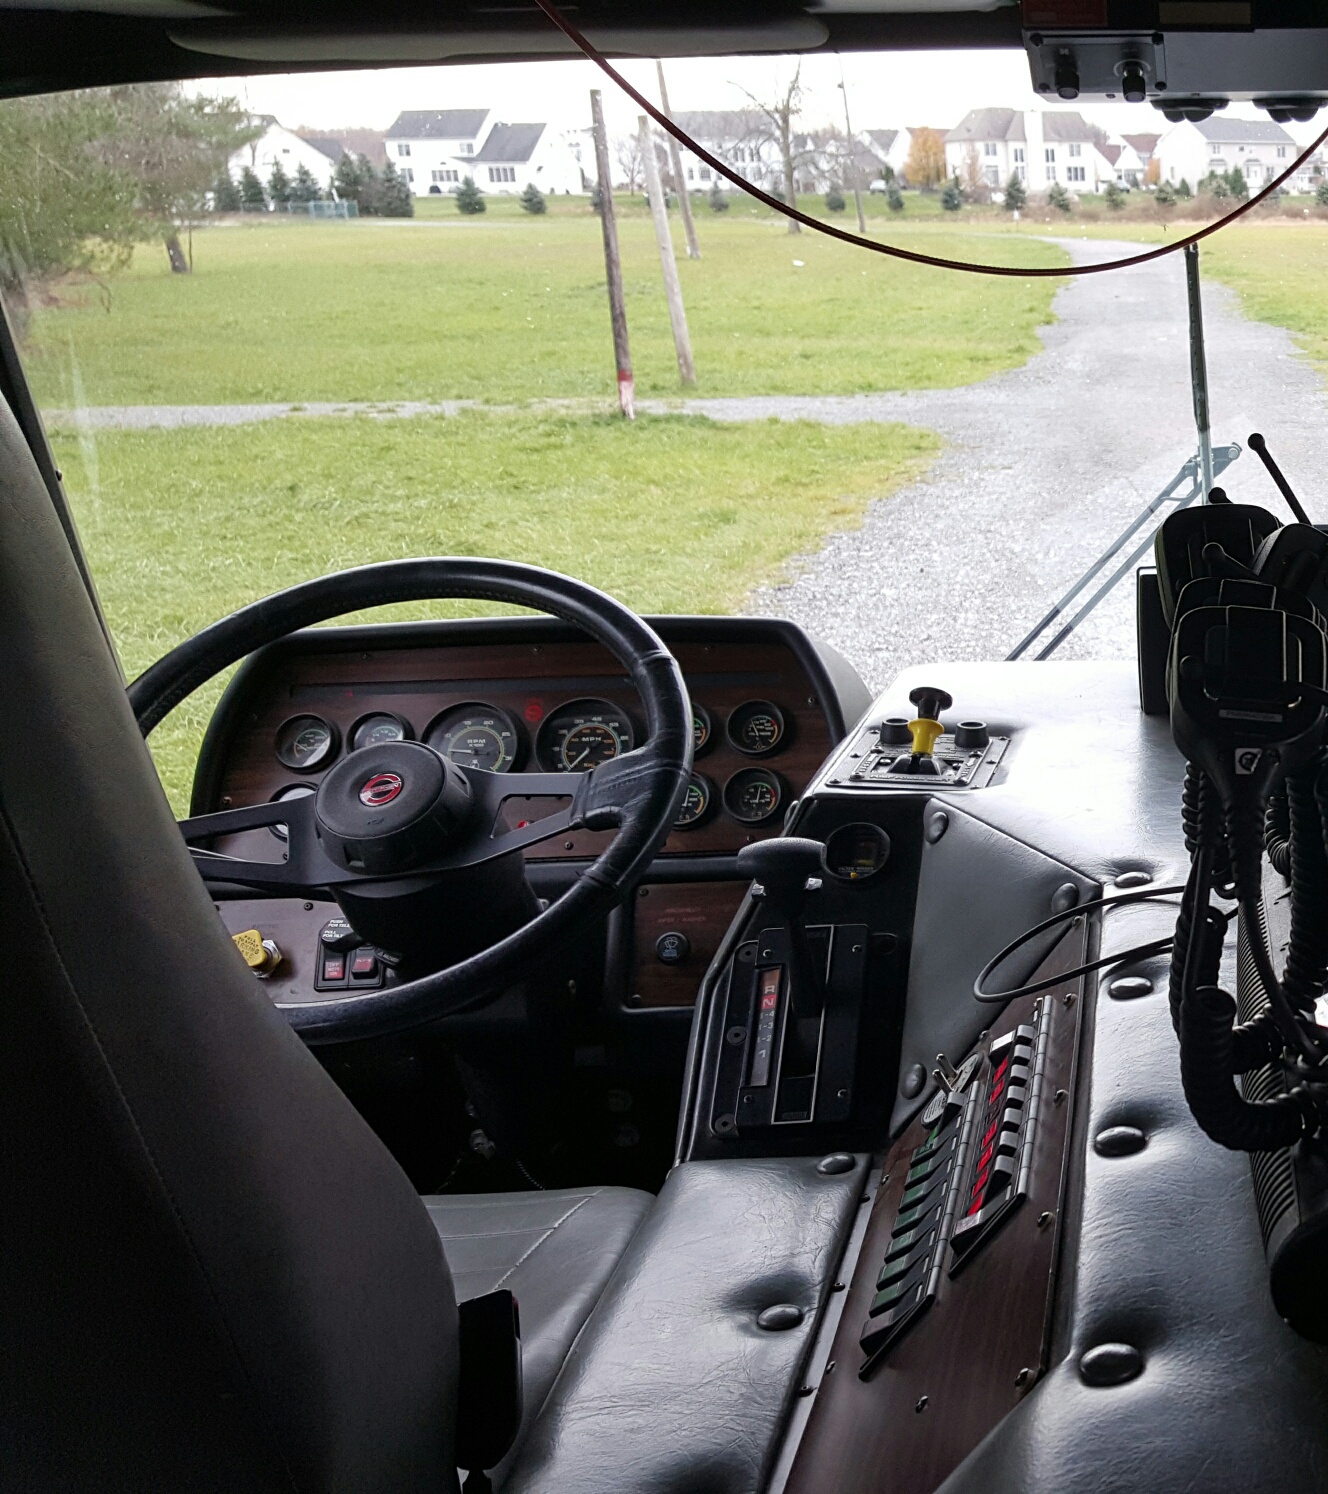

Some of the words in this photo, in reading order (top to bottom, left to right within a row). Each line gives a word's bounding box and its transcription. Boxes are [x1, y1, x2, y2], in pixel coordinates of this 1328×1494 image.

[764, 985, 775, 994] R
[762, 997, 774, 1007] N
[760, 1010, 775, 1019] 1-4
[758, 1022, 773, 1031] 1-3
[757, 1034, 772, 1043] 1-2
[758, 1049, 766, 1058] 1
